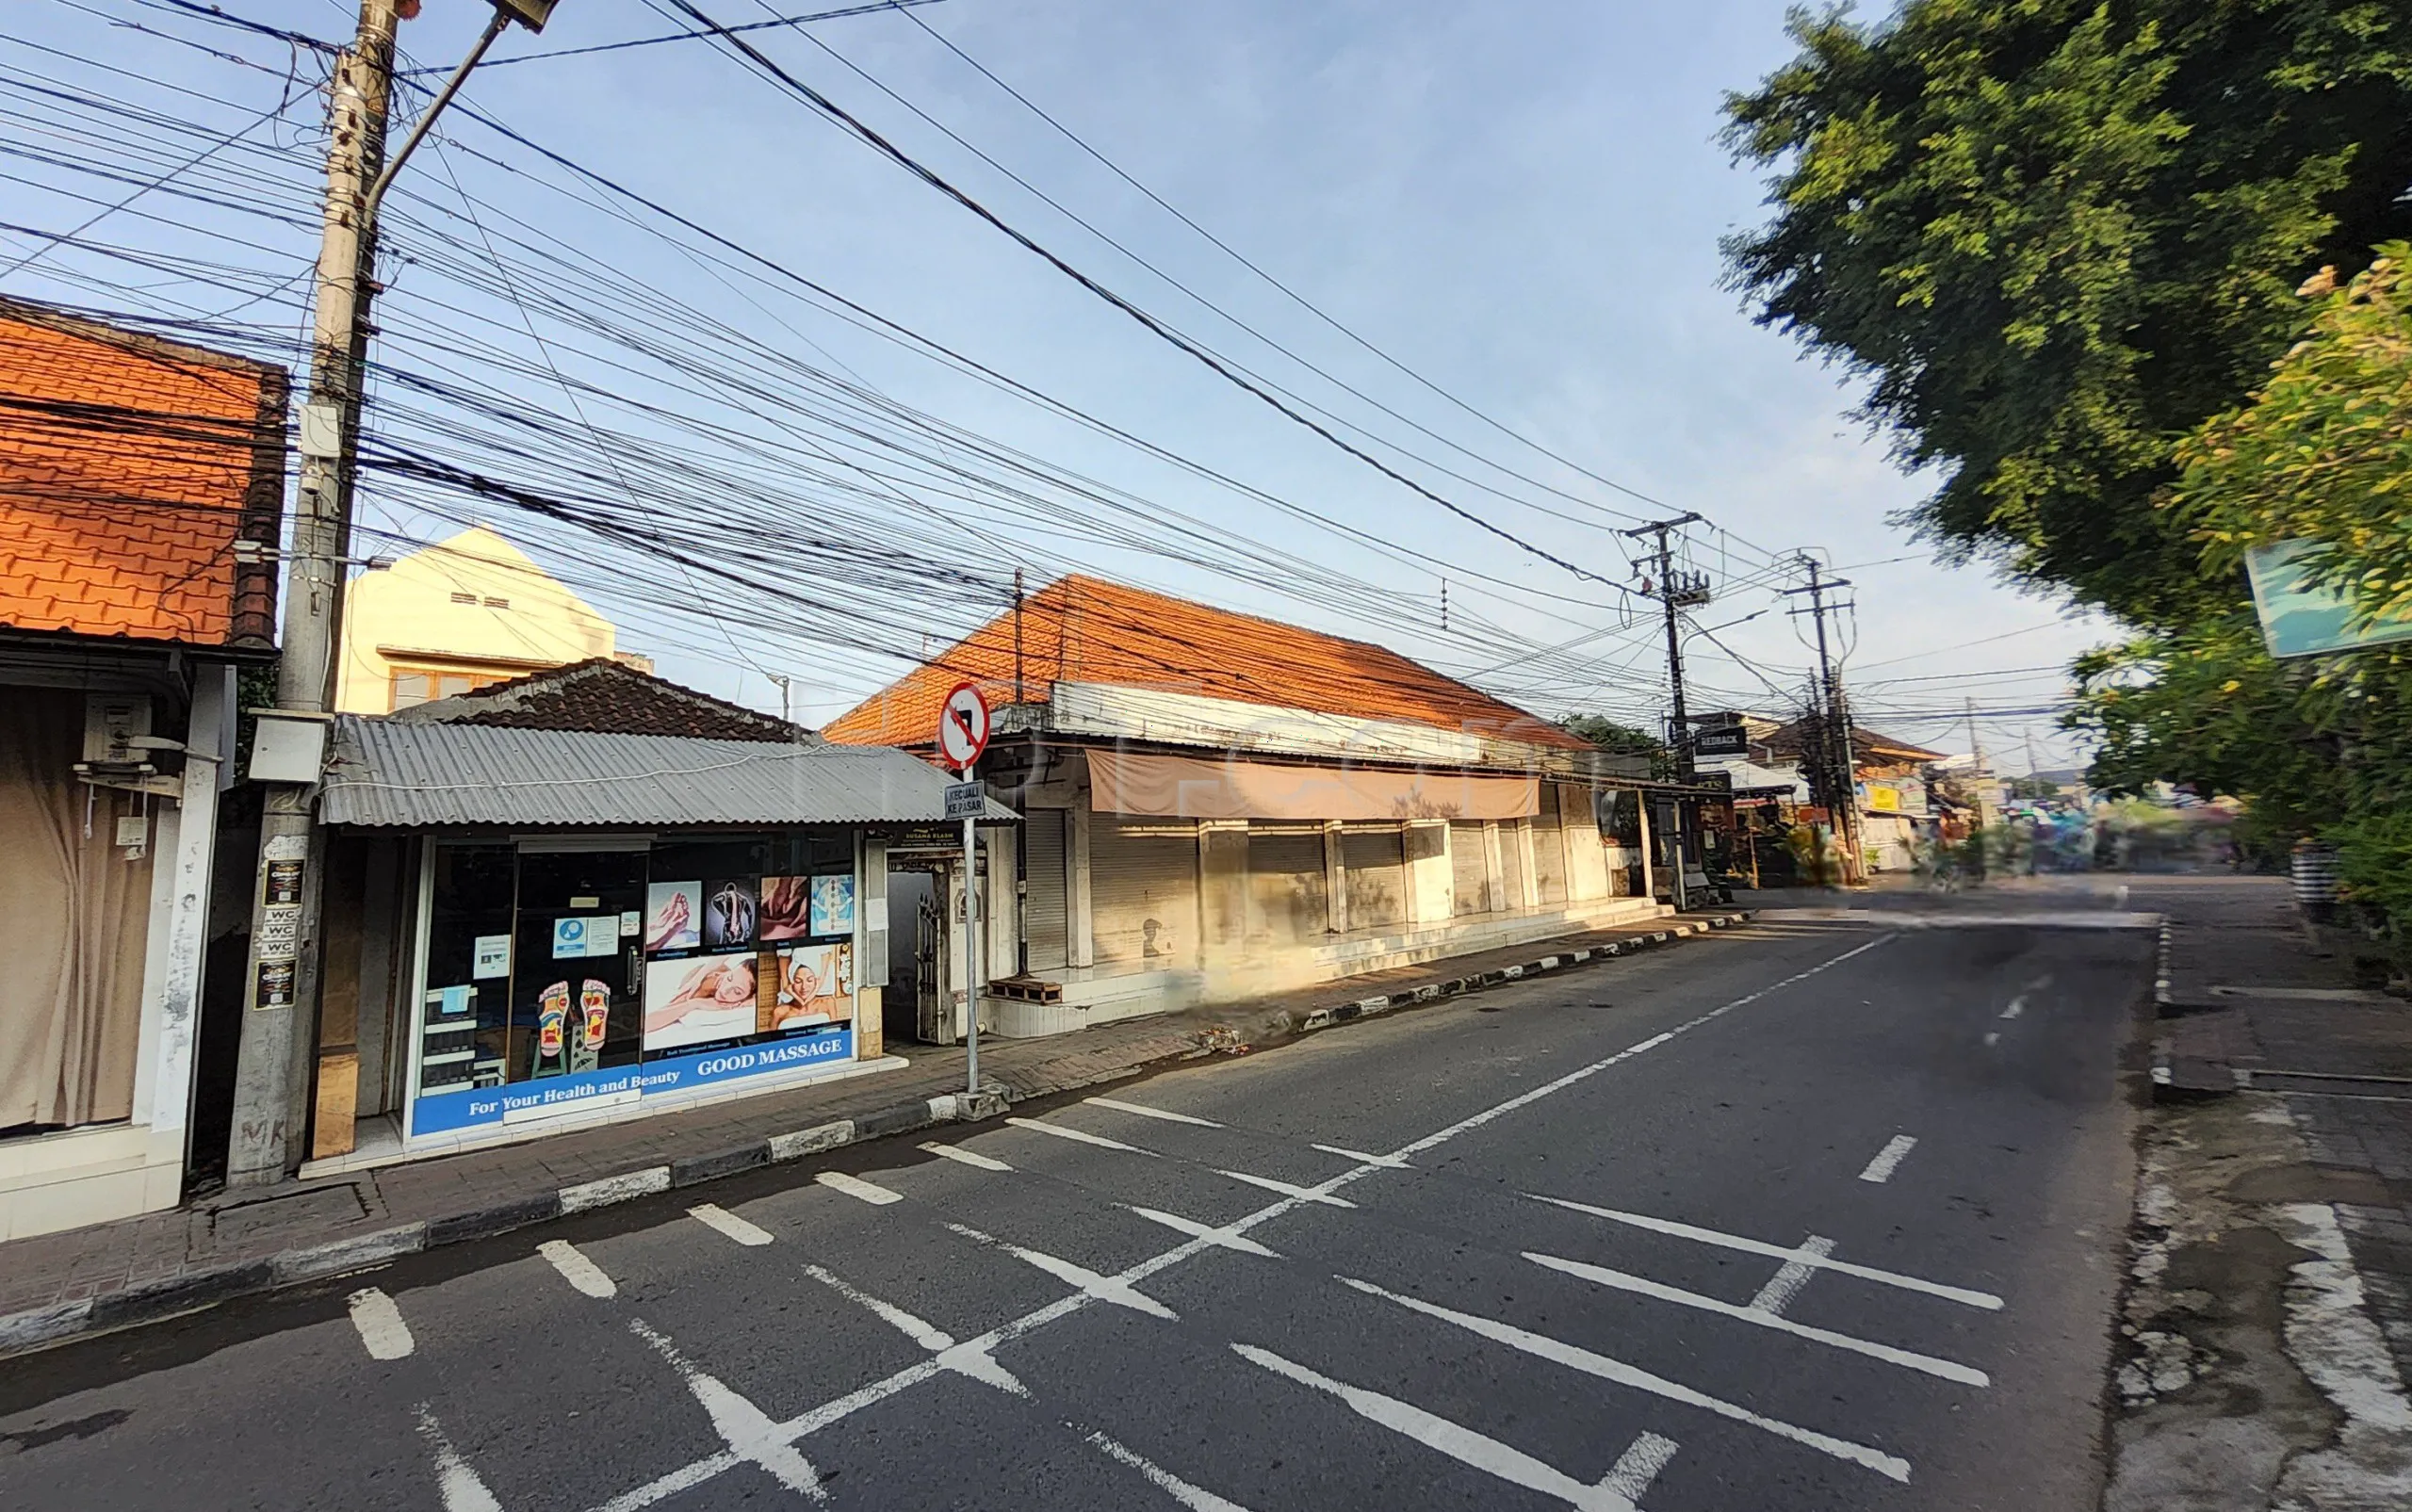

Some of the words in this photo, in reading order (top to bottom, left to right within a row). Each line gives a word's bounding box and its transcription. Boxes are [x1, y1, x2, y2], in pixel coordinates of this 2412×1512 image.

[949, 788, 979, 802] KECUALI
[947, 803, 957, 814] KE
[958, 800, 983, 813] PASAR
[271, 910, 295, 919] WC
[269, 926, 293, 935] WC
[268, 942, 292, 951] WC
[697, 1056, 755, 1076] GOOD
[758, 1038, 842, 1065] MASSAGE
[469, 1099, 498, 1116] For
[502, 1090, 541, 1110] Your
[544, 1081, 596, 1106] Health
[597, 1079, 628, 1094] and
[629, 1068, 681, 1093] Beauty
